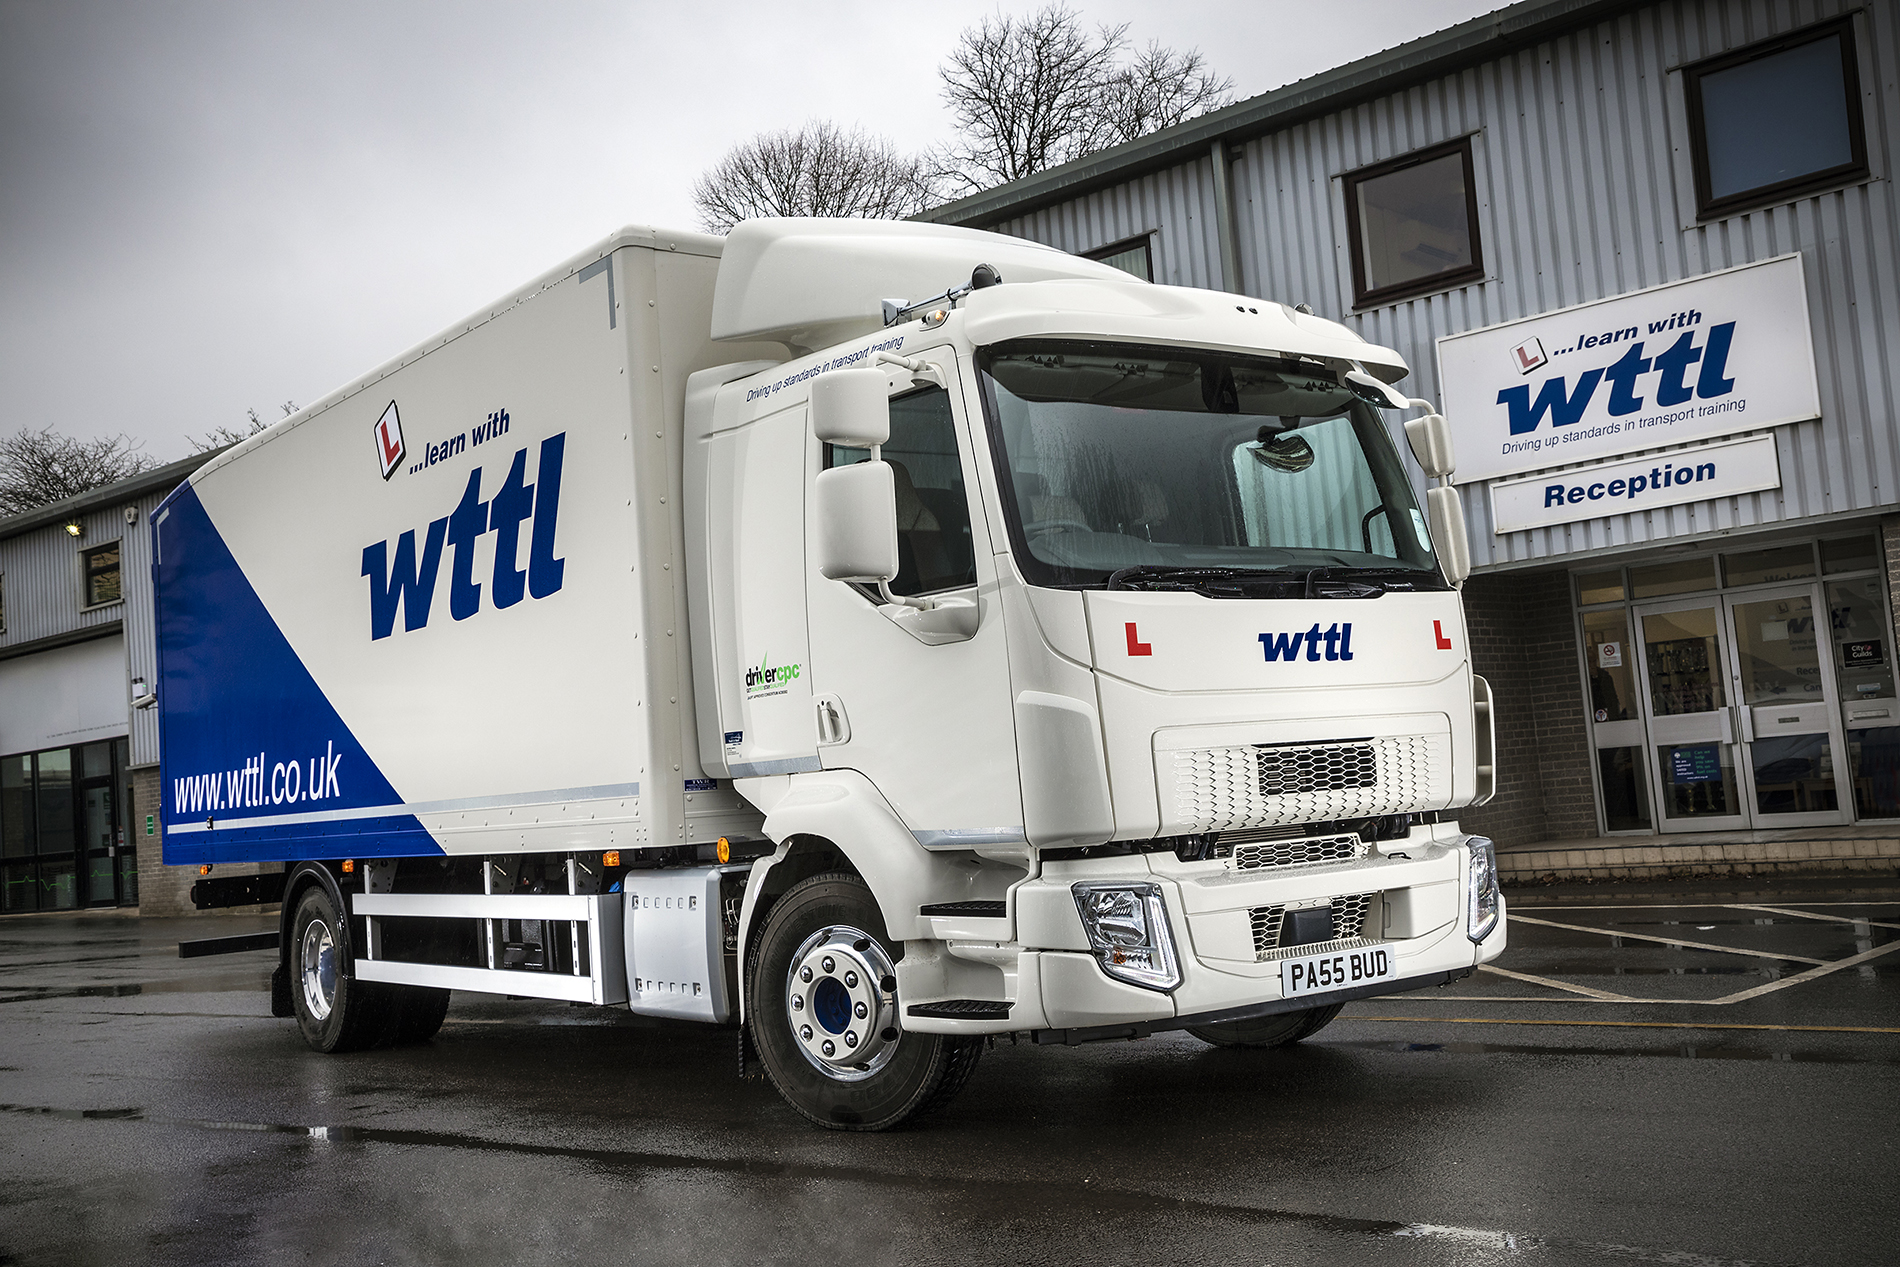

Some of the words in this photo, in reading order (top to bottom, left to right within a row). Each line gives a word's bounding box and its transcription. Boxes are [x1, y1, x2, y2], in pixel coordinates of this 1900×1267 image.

[1648, 309, 1702, 334] with
[746, 385, 771, 402] Driving
[772, 381, 782, 394] up
[783, 364, 821, 388] standards
[822, 361, 830, 373] in
[831, 346, 870, 370] transport
[870, 335, 904, 353] training
[1496, 320, 1737, 436] wttl
[1516, 346, 1540, 369] L
[380, 420, 400, 467] L
[472, 407, 510, 447] with
[1502, 438, 1541, 455] Driving
[1545, 435, 1559, 448] up
[1562, 422, 1621, 443] standards
[1625, 419, 1635, 431] in
[1639, 408, 1694, 429] transport
[1699, 399, 1746, 418] training
[1544, 462, 1716, 508] Reception
[361, 430, 566, 642] wttl
[1124, 621, 1153, 657] L
[1257, 622, 1354, 662] wttl
[1432, 619, 1452, 650] L
[174, 740, 342, 814] www.wttl.co.uk
[1291, 956, 1345, 992] PA55
[1350, 949, 1388, 982] BUD
